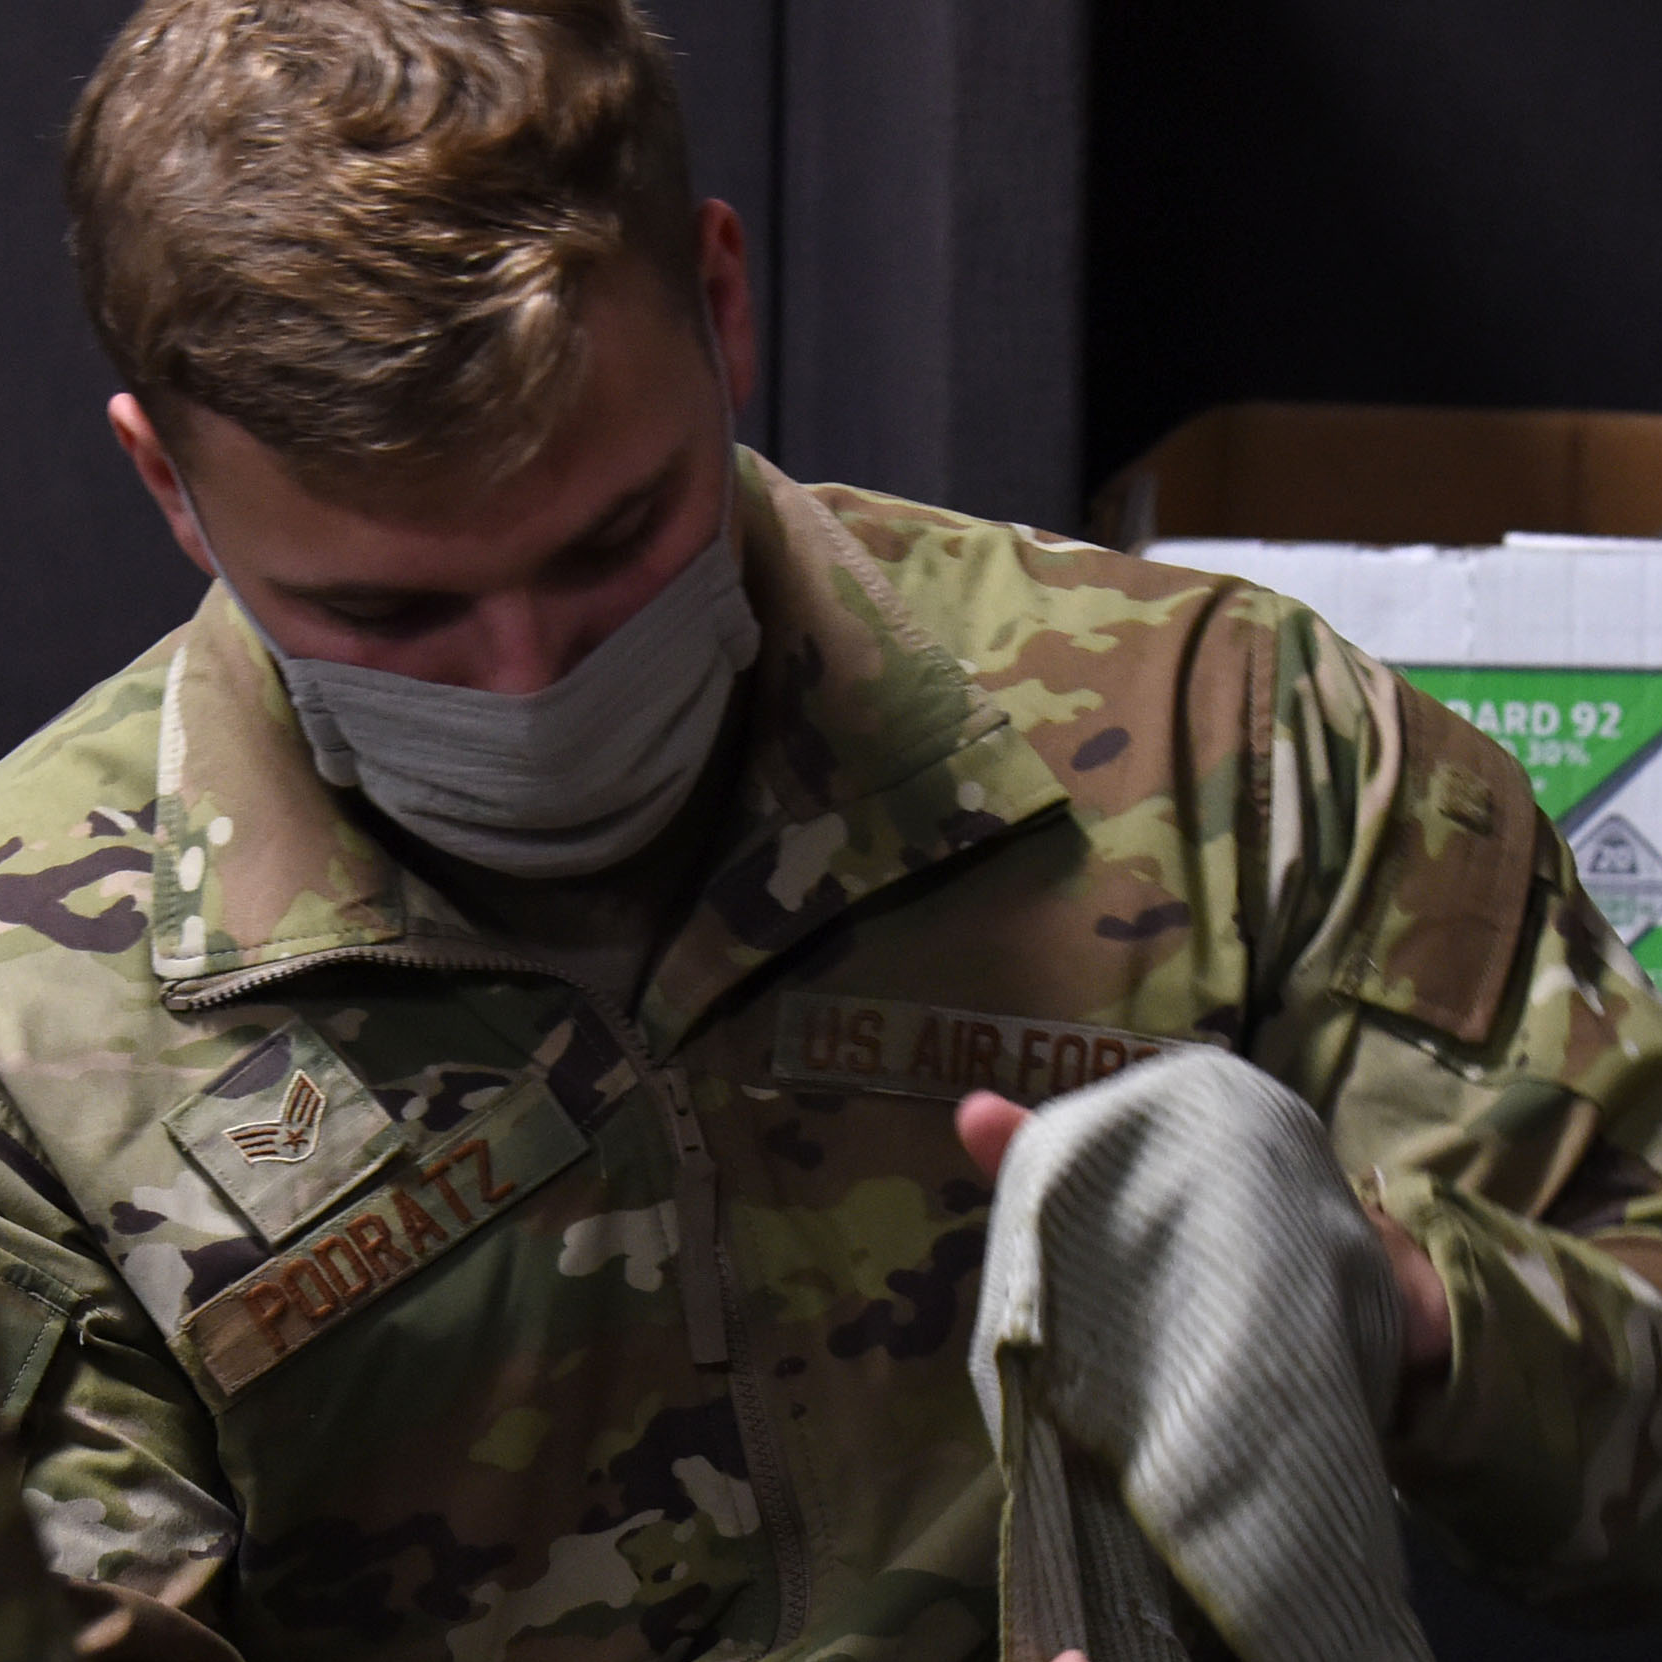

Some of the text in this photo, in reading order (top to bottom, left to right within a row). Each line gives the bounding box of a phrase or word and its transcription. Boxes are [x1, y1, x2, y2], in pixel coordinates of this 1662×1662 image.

[1571, 702, 1622, 738] 92
[908, 1014, 1003, 1088] AIR
[1016, 1028, 1161, 1096] FOR
[243, 1139, 516, 1354] PODRATZ
